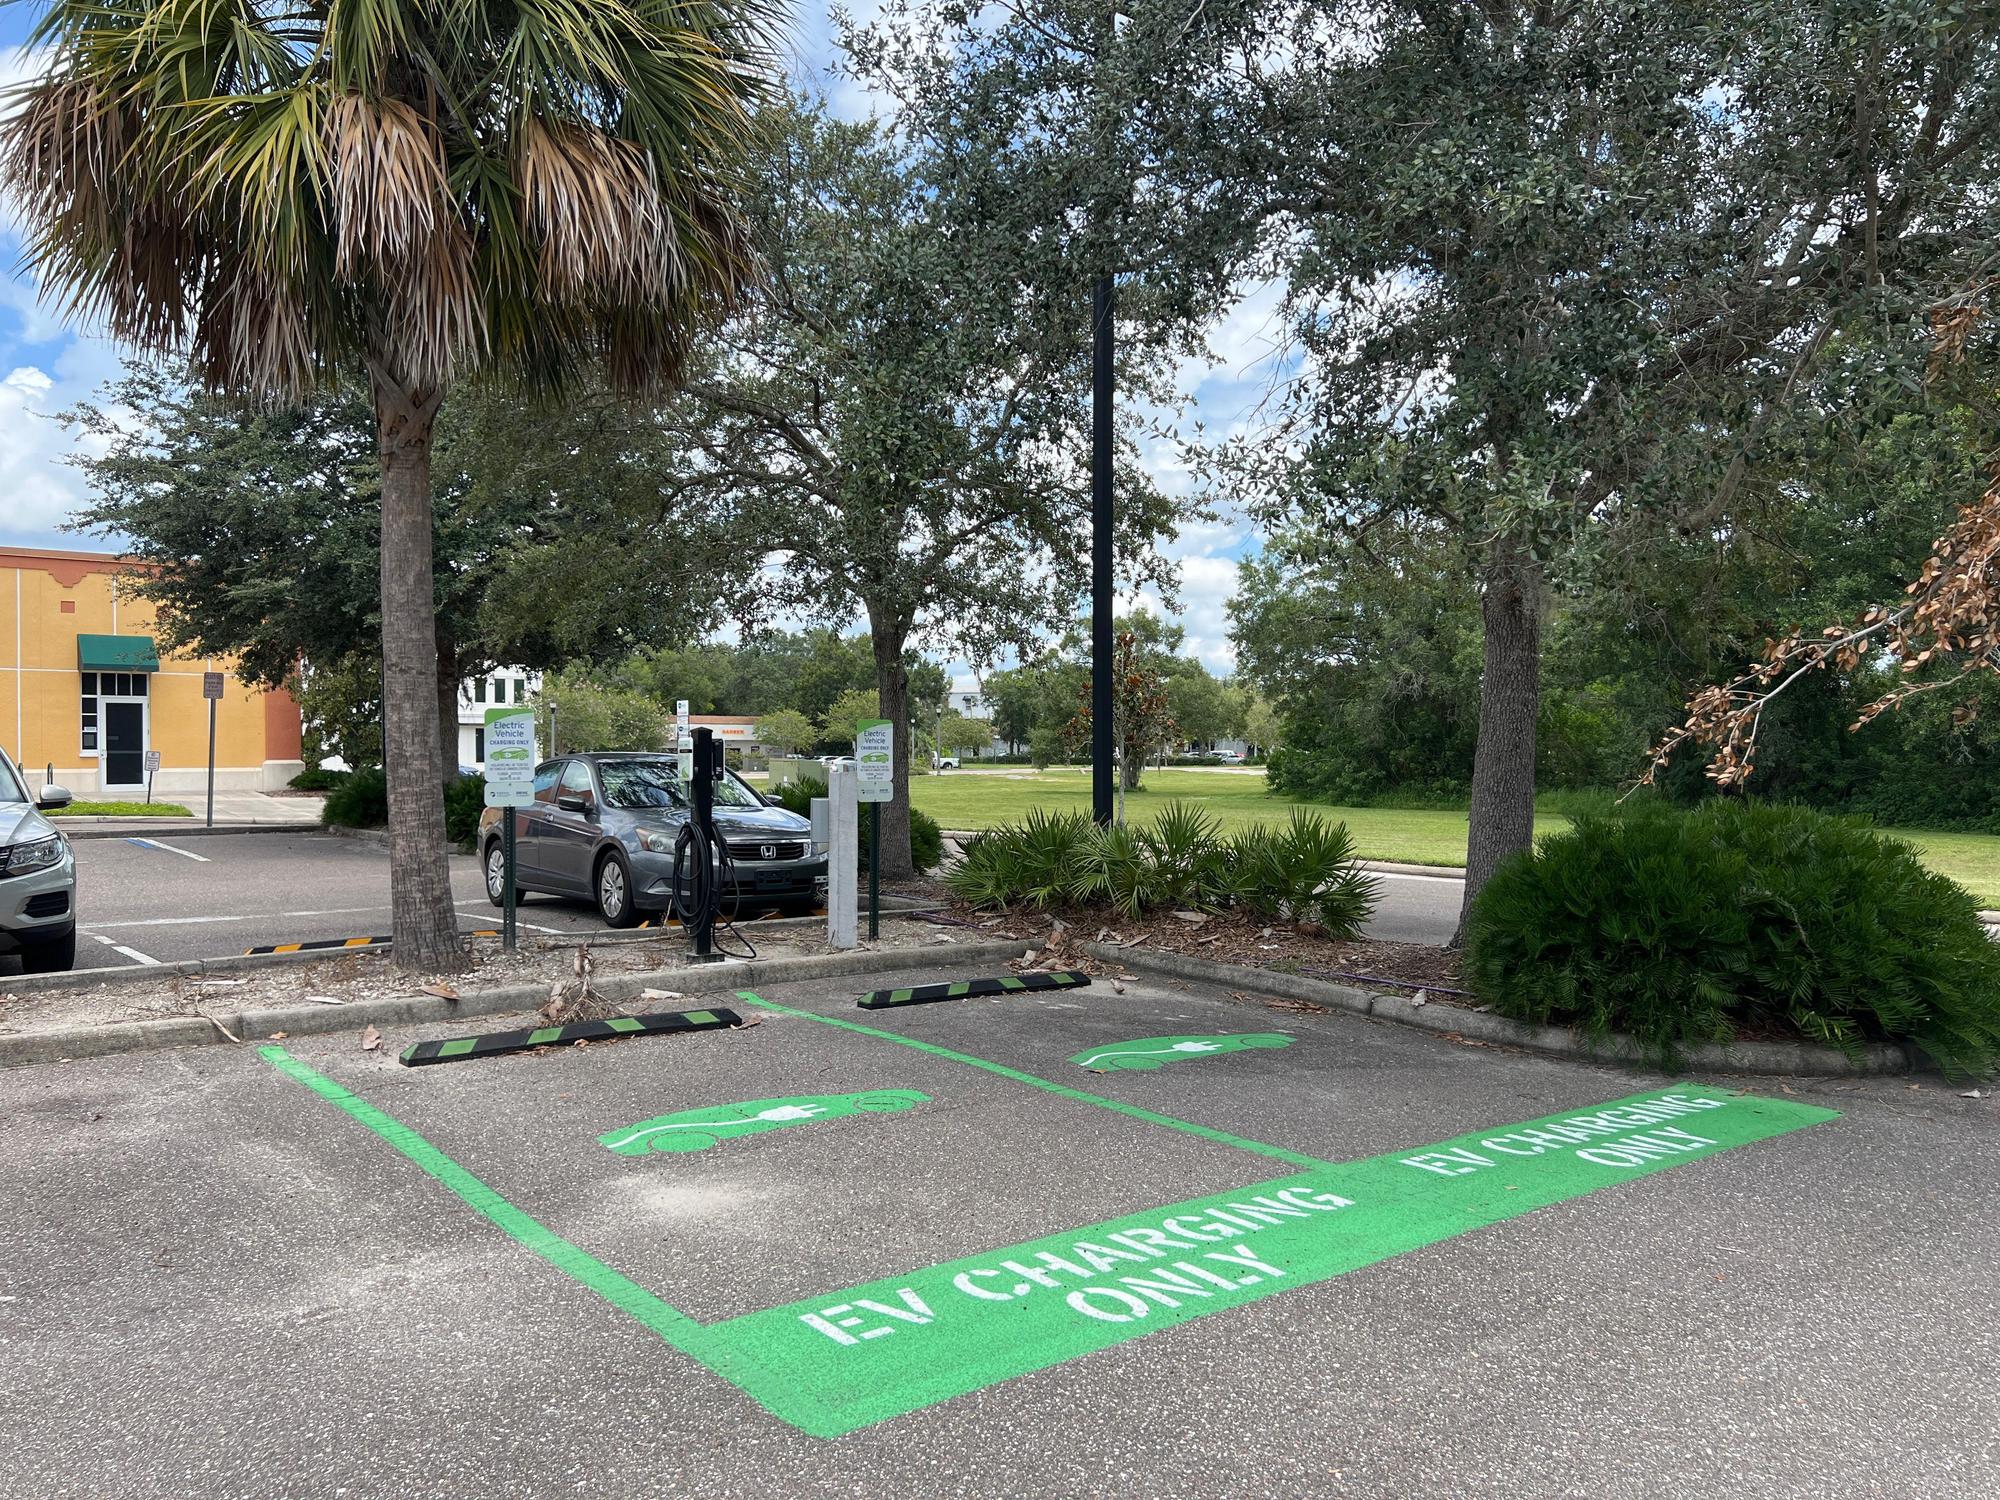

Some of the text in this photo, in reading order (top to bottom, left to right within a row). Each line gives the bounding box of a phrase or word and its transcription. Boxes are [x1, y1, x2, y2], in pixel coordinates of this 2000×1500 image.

[1399, 1094, 1727, 1176] EV CHARGING
[1576, 1126, 1718, 1167] ONLY
[799, 1187, 1356, 1346] EV CHARGING
[1066, 1244, 1287, 1323] ONLY
